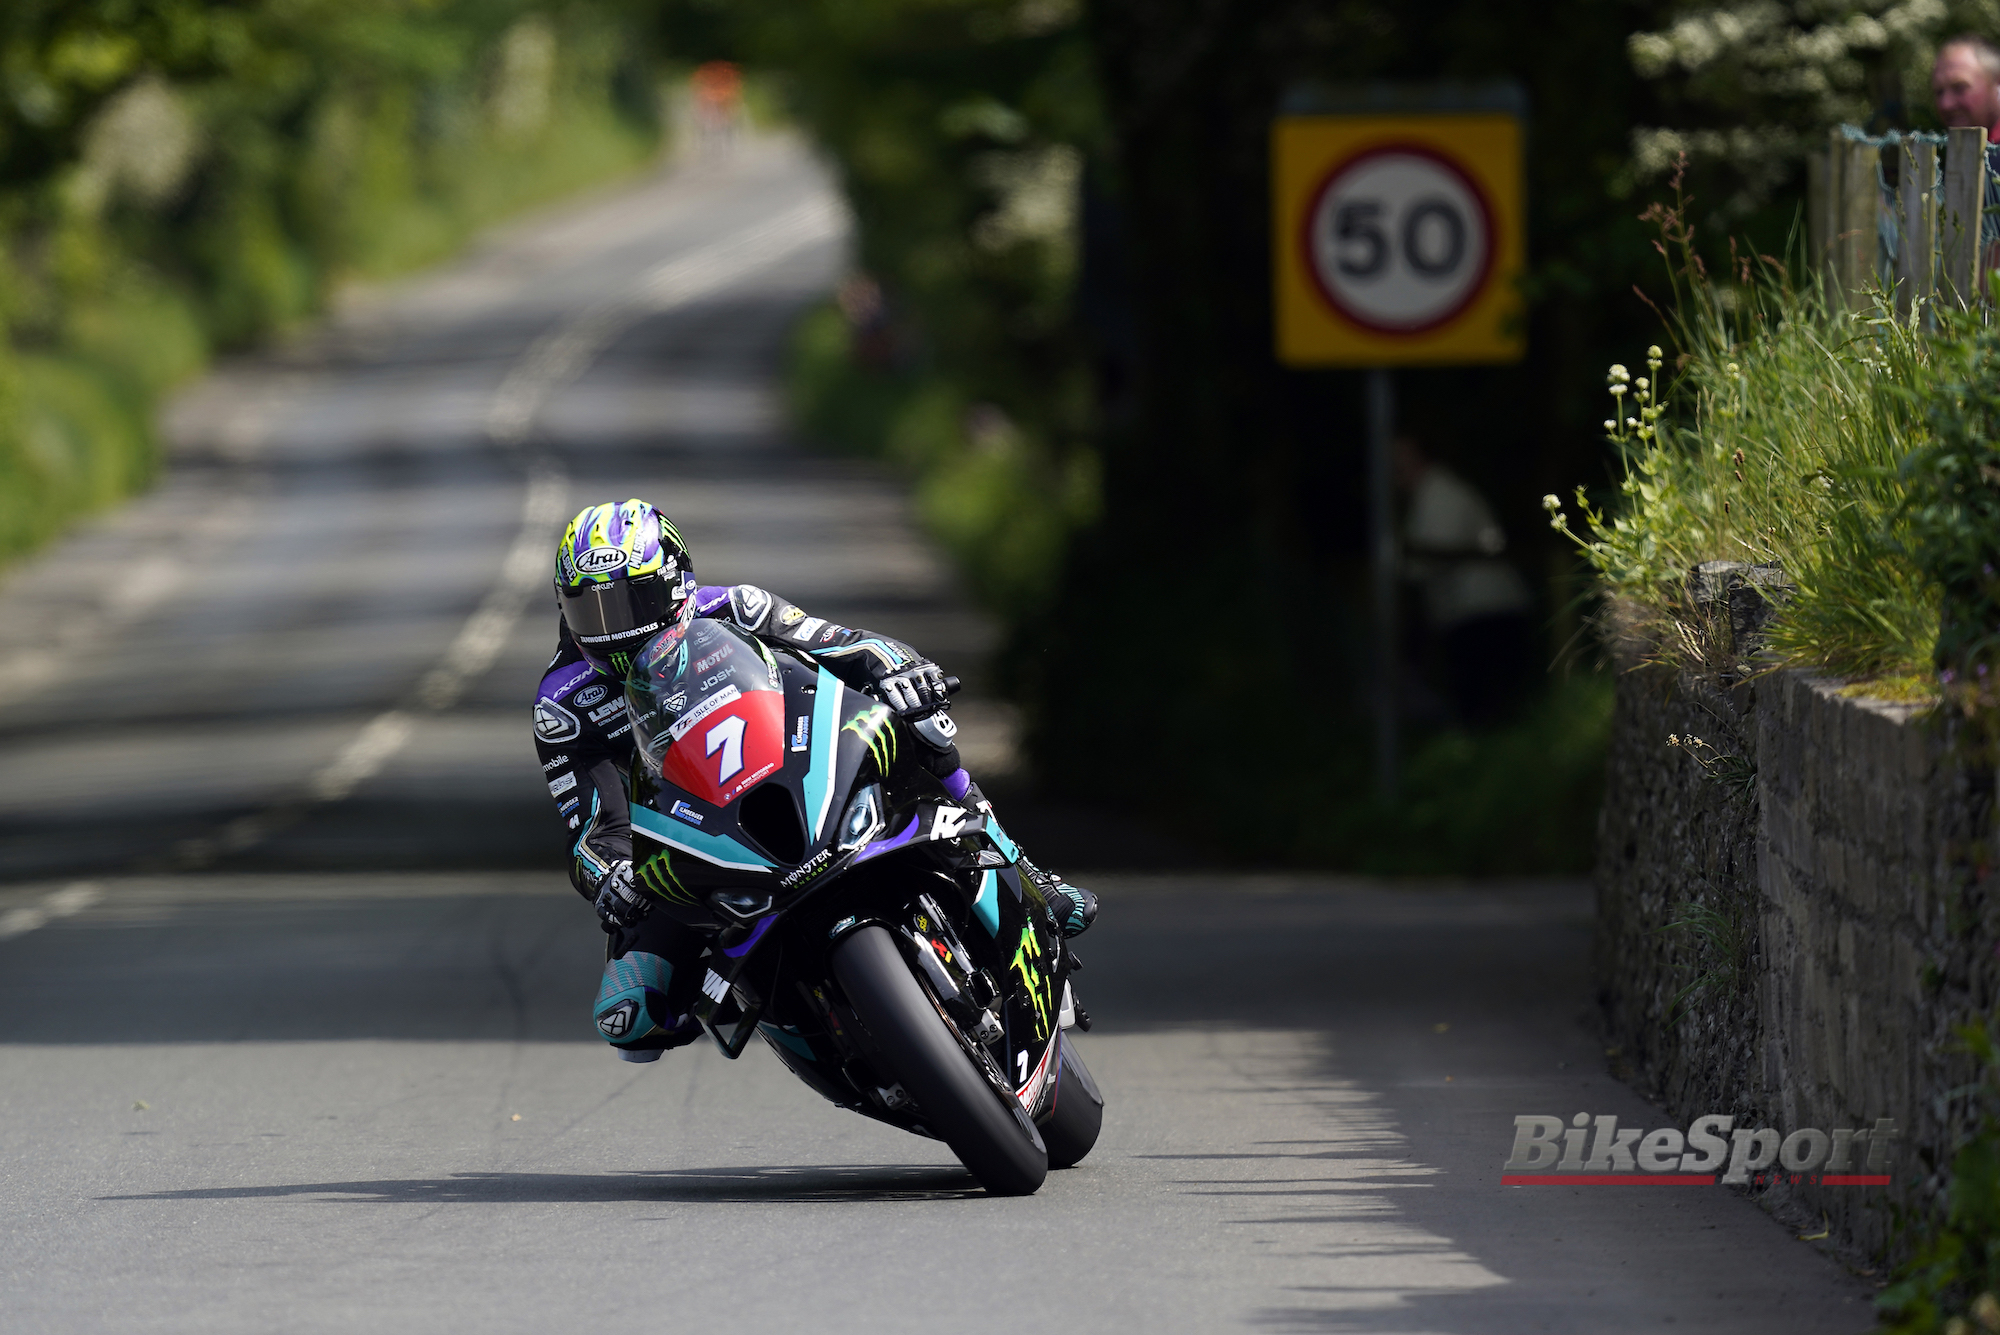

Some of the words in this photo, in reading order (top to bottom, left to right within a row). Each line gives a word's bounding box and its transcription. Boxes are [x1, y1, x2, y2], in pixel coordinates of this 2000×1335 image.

[1335, 199, 1467, 279] 50
[580, 549, 620, 570] Arai
[611, 622, 659, 641] MOTORCYCLES
[696, 643, 734, 673] MOTUL
[700, 665, 737, 692] JOSH
[580, 688, 603, 703] Arai
[693, 704, 709, 718] ISLE
[709, 698, 719, 708] OF
[720, 688, 737, 700] MAN
[542, 754, 569, 772] mobile
[705, 714, 748, 788] 7
[780, 848, 832, 888] MONSTER
[793, 862, 828, 889] ENERGY
